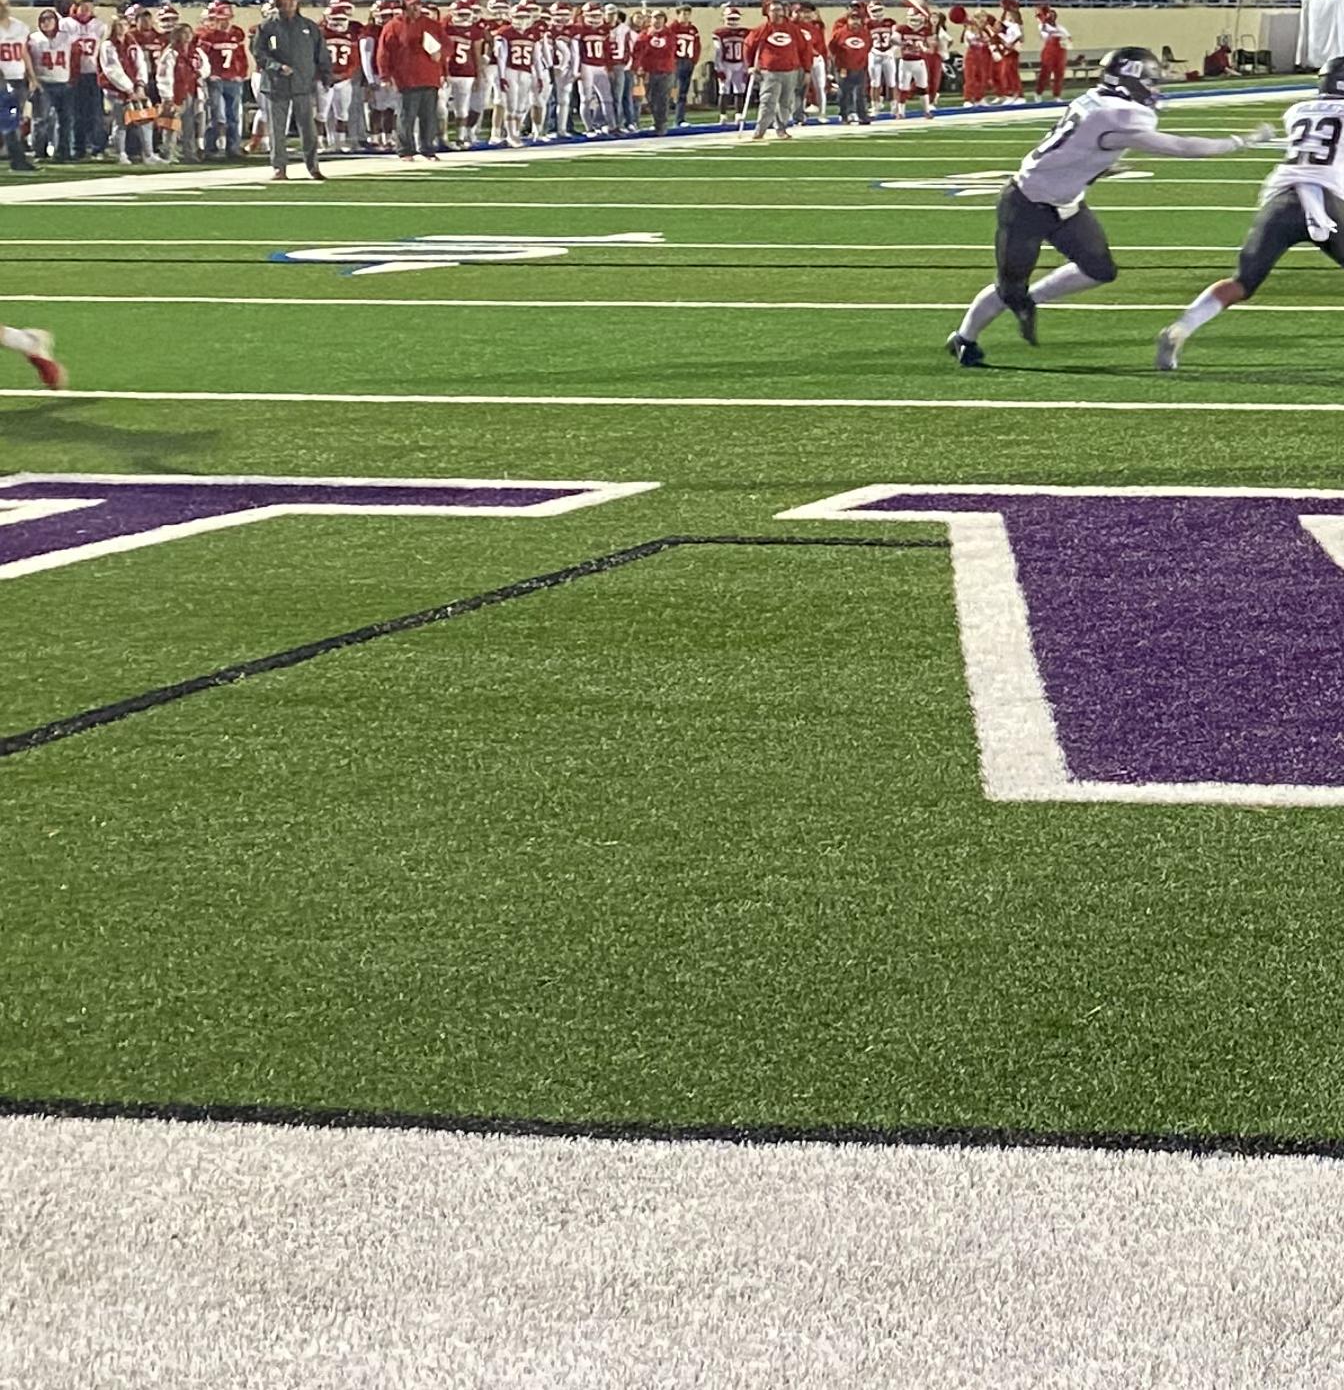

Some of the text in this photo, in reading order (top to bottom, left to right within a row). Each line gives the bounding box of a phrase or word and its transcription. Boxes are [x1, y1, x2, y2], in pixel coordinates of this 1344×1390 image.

[586, 40, 604, 59] 10
[676, 38, 694, 59] 34
[871, 32, 891, 48] 23
[42, 50, 66, 70] 44
[221, 49, 233, 68] 7
[455, 42, 471, 64] 5
[511, 46, 533, 65] 25
[725, 41, 742, 61] 30
[1286, 116, 1343, 166] 23
